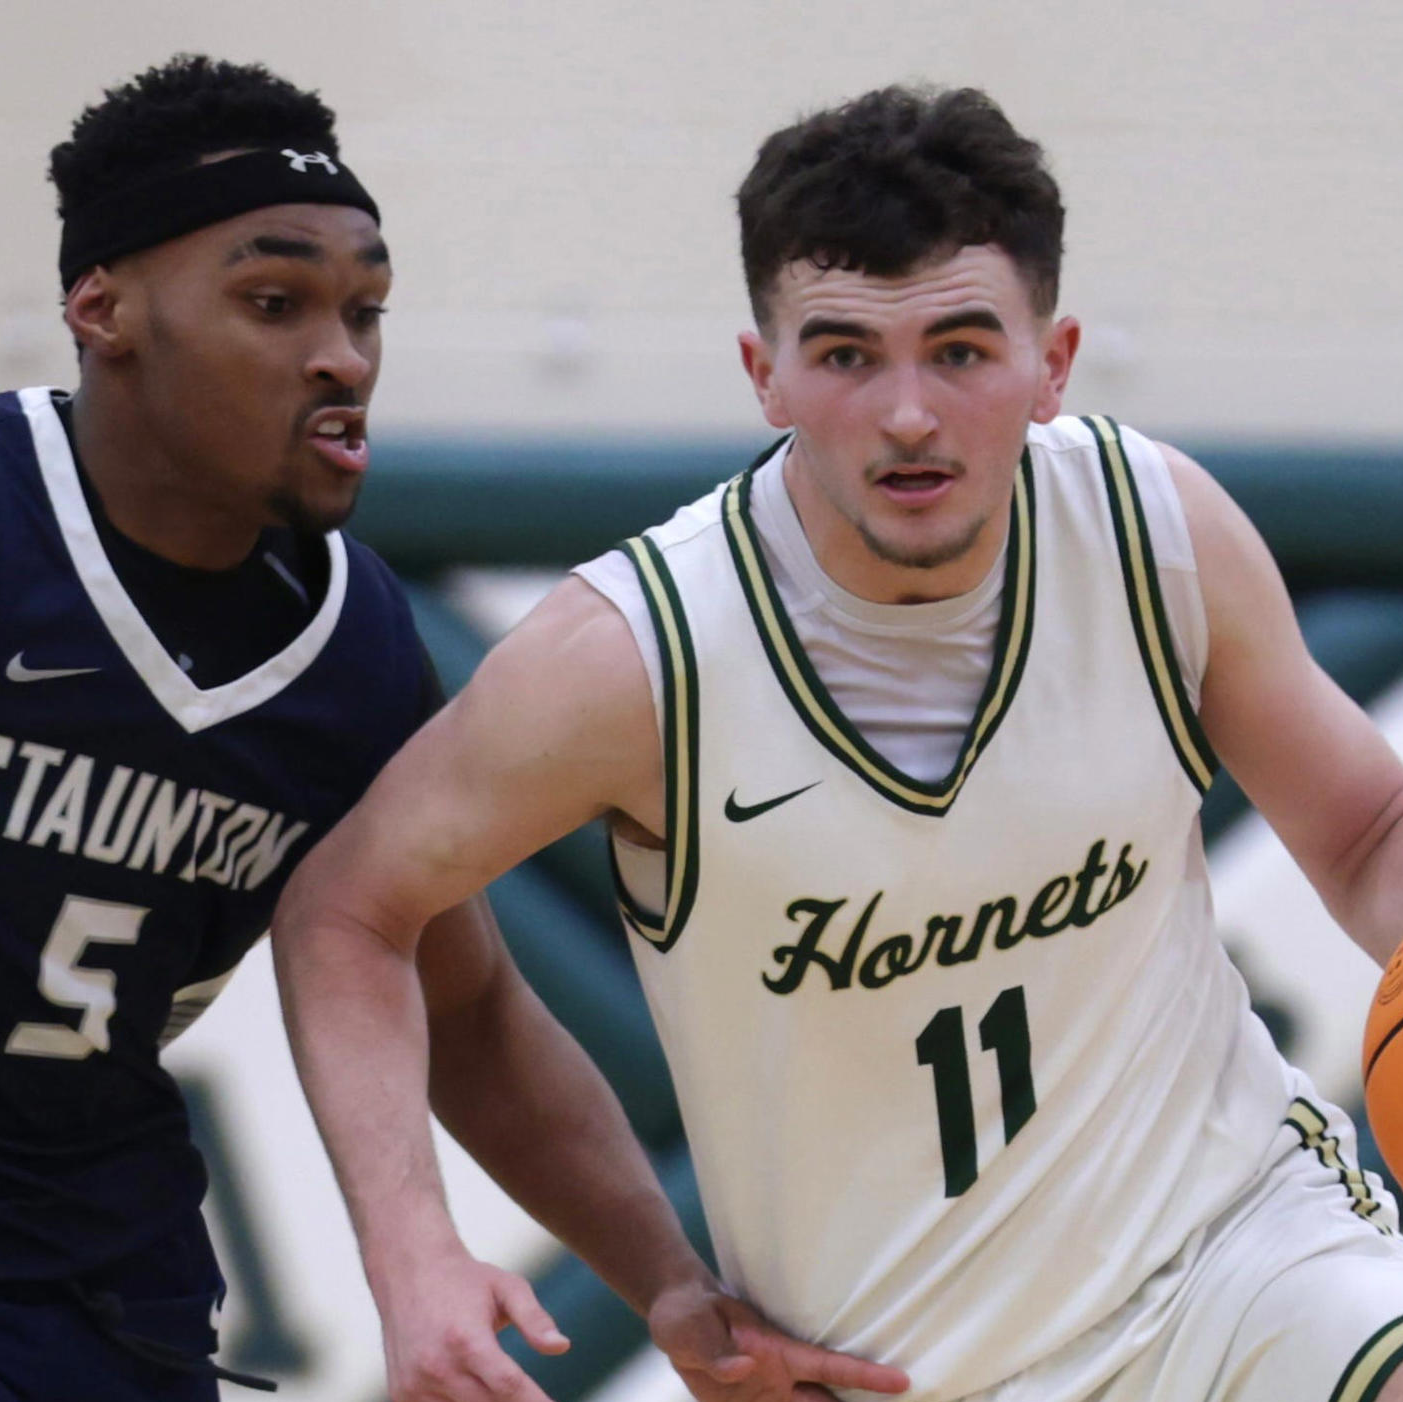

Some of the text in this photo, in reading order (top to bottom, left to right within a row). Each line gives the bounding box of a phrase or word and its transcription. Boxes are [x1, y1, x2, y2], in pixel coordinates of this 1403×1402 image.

[4, 893, 153, 1060] 5
[760, 837, 1150, 996] Hornets
[914, 983, 1038, 1200] 11
